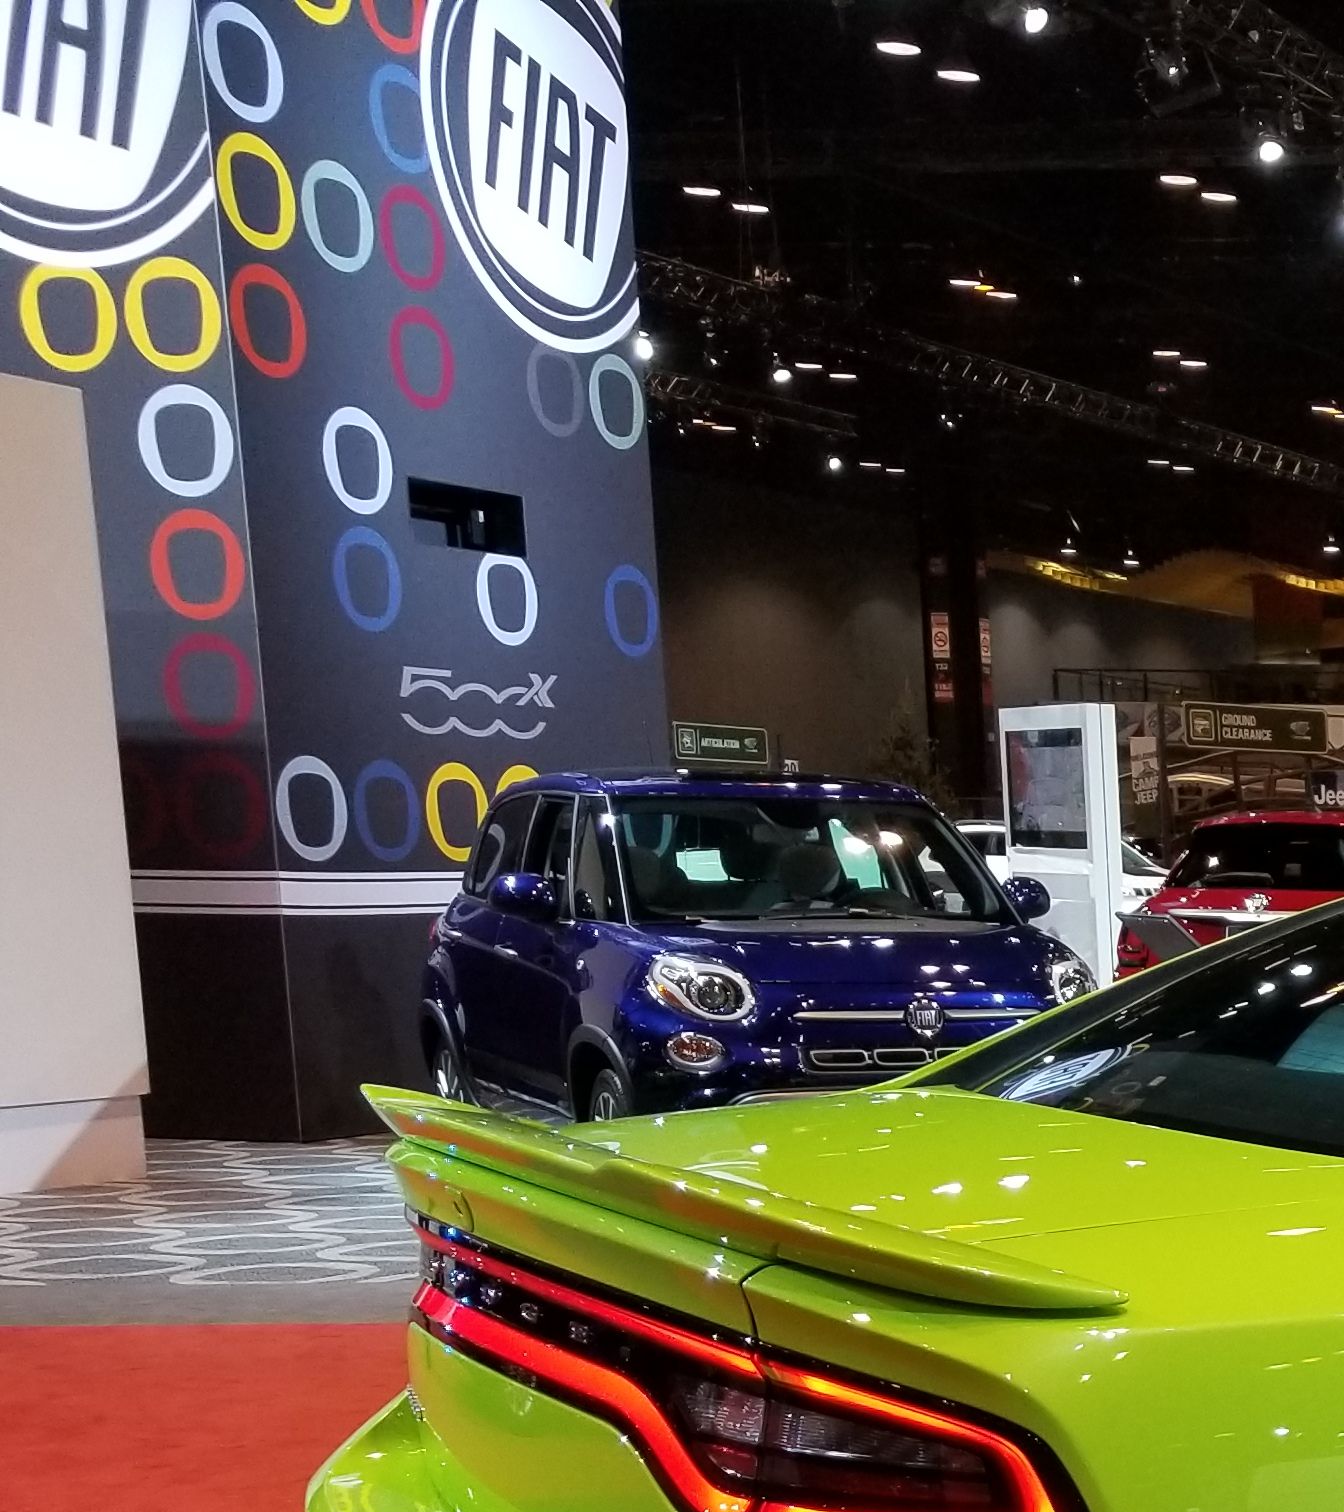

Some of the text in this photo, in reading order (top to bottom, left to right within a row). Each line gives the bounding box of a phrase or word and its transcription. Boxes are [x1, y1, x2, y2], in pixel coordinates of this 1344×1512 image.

[484, 28, 617, 263] FIAT
[1222, 713, 1257, 727] GROUND
[1222, 727, 1273, 742] CLEARANCE
[1132, 776, 1159, 791] CAMP
[1134, 789, 1159, 805] JEEP
[915, 1010, 936, 1026] FIAT
